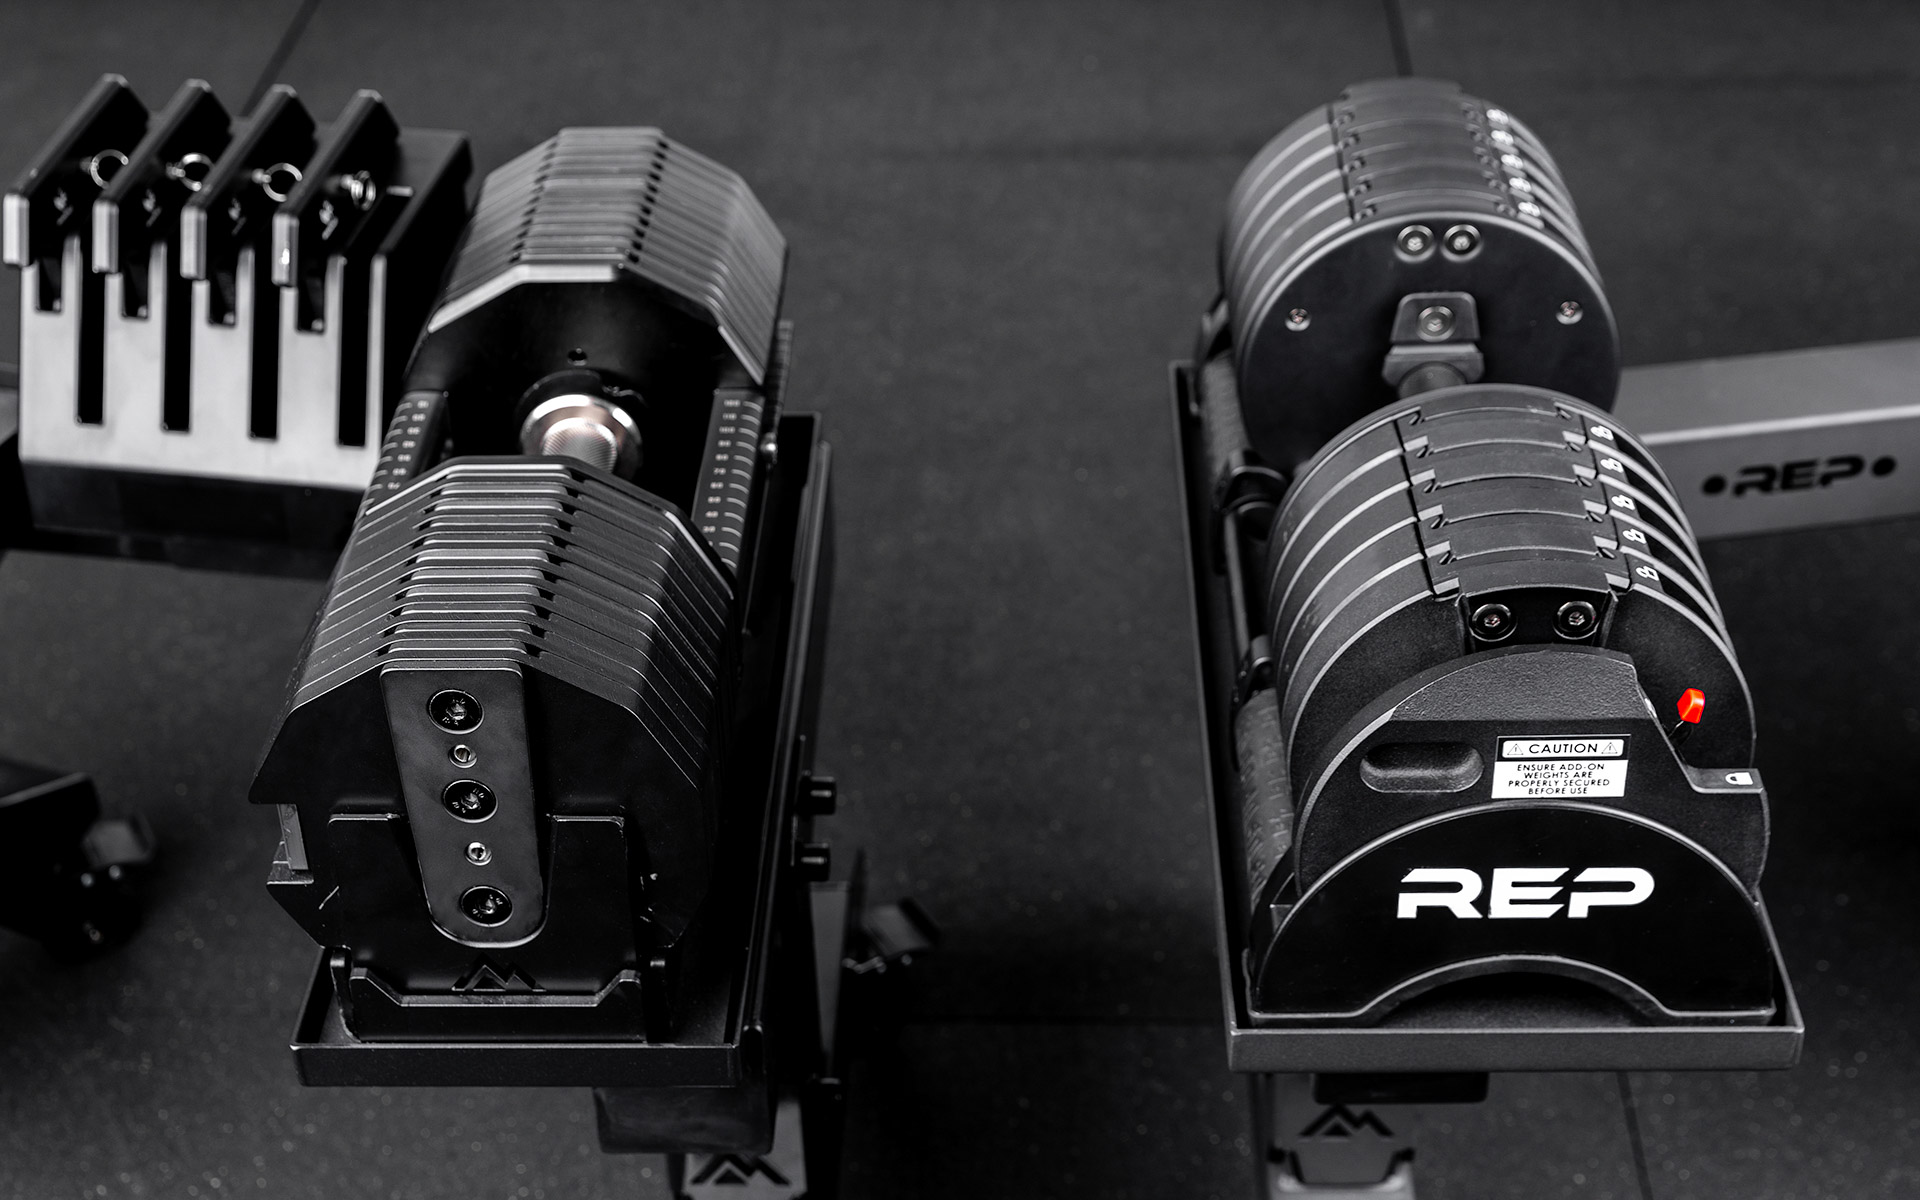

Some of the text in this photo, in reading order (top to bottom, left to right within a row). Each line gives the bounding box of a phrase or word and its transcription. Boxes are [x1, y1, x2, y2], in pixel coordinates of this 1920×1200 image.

[1733, 456, 1865, 497] REP
[1528, 744, 1598, 754] CAUTION
[1516, 763, 1605, 772] ENSURE ADD-ON
[1523, 772, 1570, 780] WEIGHTS
[1508, 779, 1610, 788] PROPERLY SECURED
[1570, 787, 1587, 795] USE
[1397, 868, 1654, 918] REP
